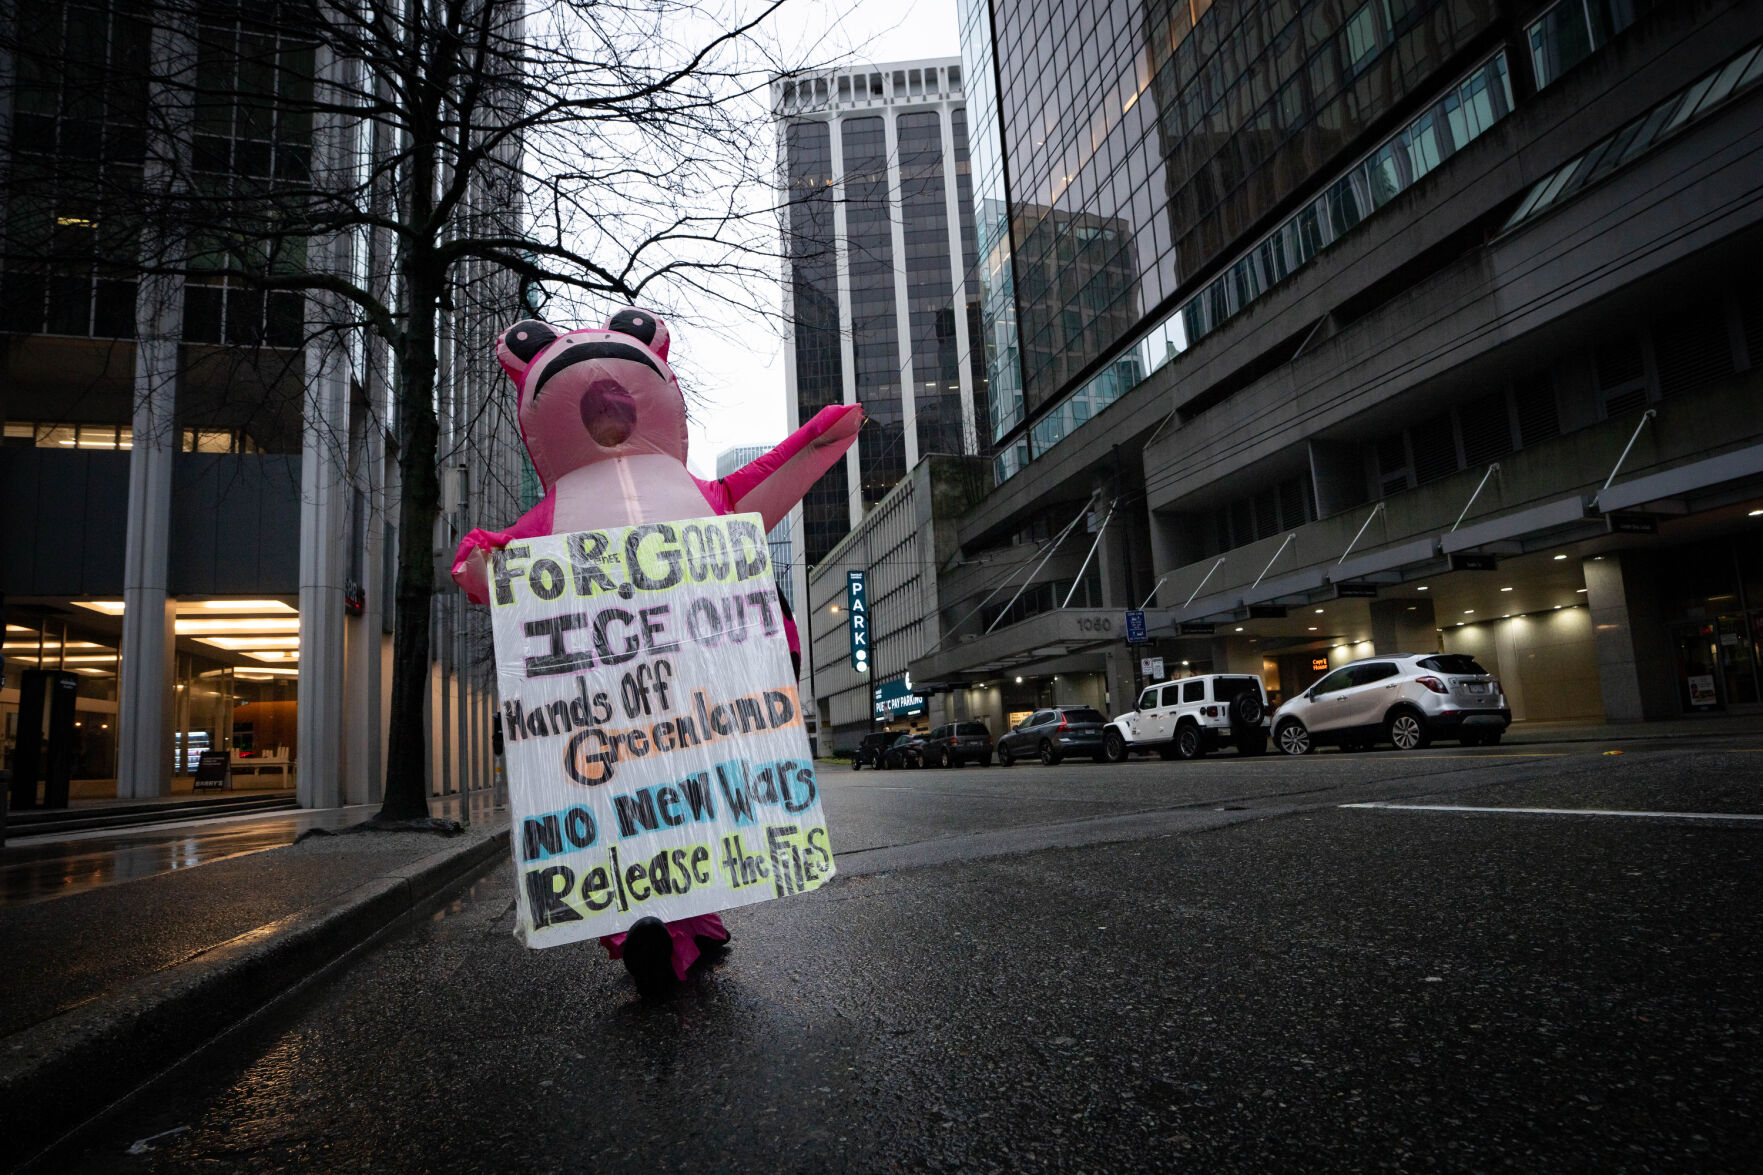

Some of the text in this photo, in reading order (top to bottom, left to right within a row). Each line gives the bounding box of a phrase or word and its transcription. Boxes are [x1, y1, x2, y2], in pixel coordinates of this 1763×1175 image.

[523, 590, 780, 678] ICE OUT
[852, 583, 866, 645] PARK
[504, 676, 613, 741] Hands
[875, 699, 891, 713] PUBC
[891, 696, 901, 710] PAY
[523, 807, 597, 861] NO
[526, 845, 711, 930] Release
[722, 836, 770, 889] the
